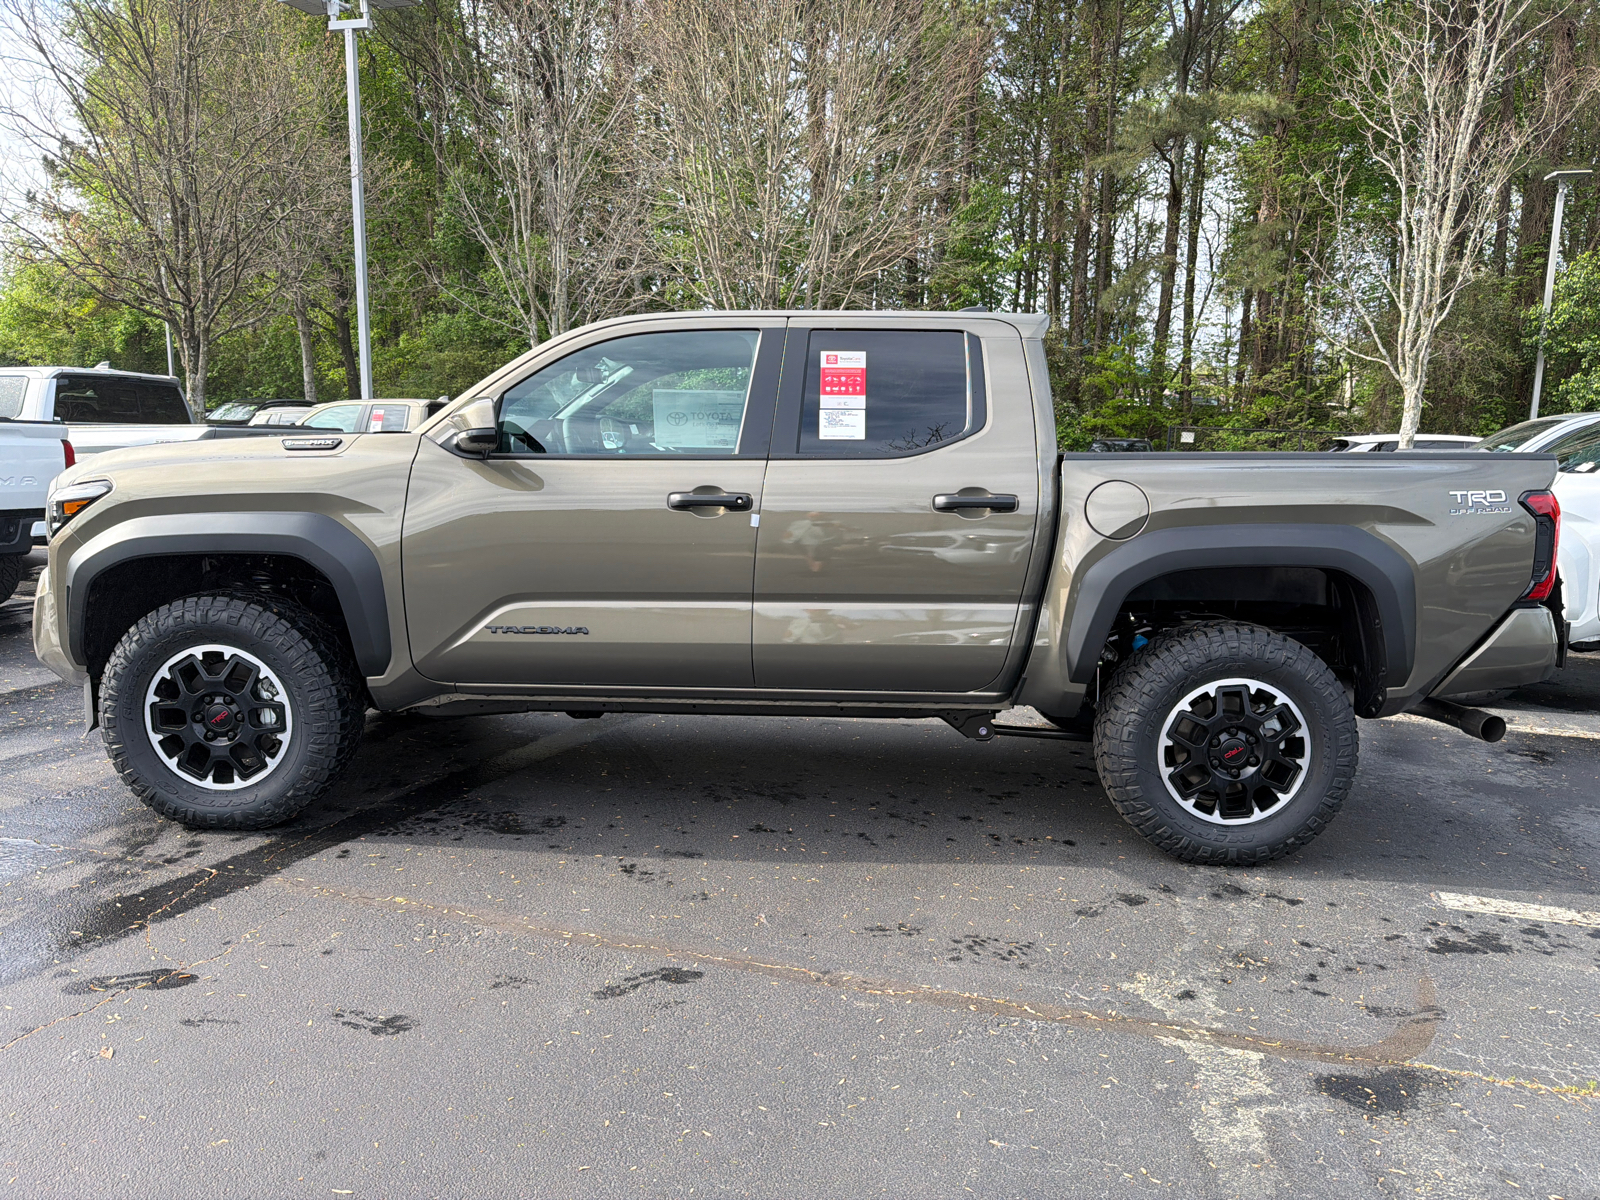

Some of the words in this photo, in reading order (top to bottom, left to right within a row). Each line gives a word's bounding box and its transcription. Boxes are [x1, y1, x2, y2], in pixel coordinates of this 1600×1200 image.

[690, 412, 733, 420] TOYOTA
[1449, 490, 1508, 506] TRD
[484, 625, 589, 635] TACOMA
[211, 710, 229, 724] TRD
